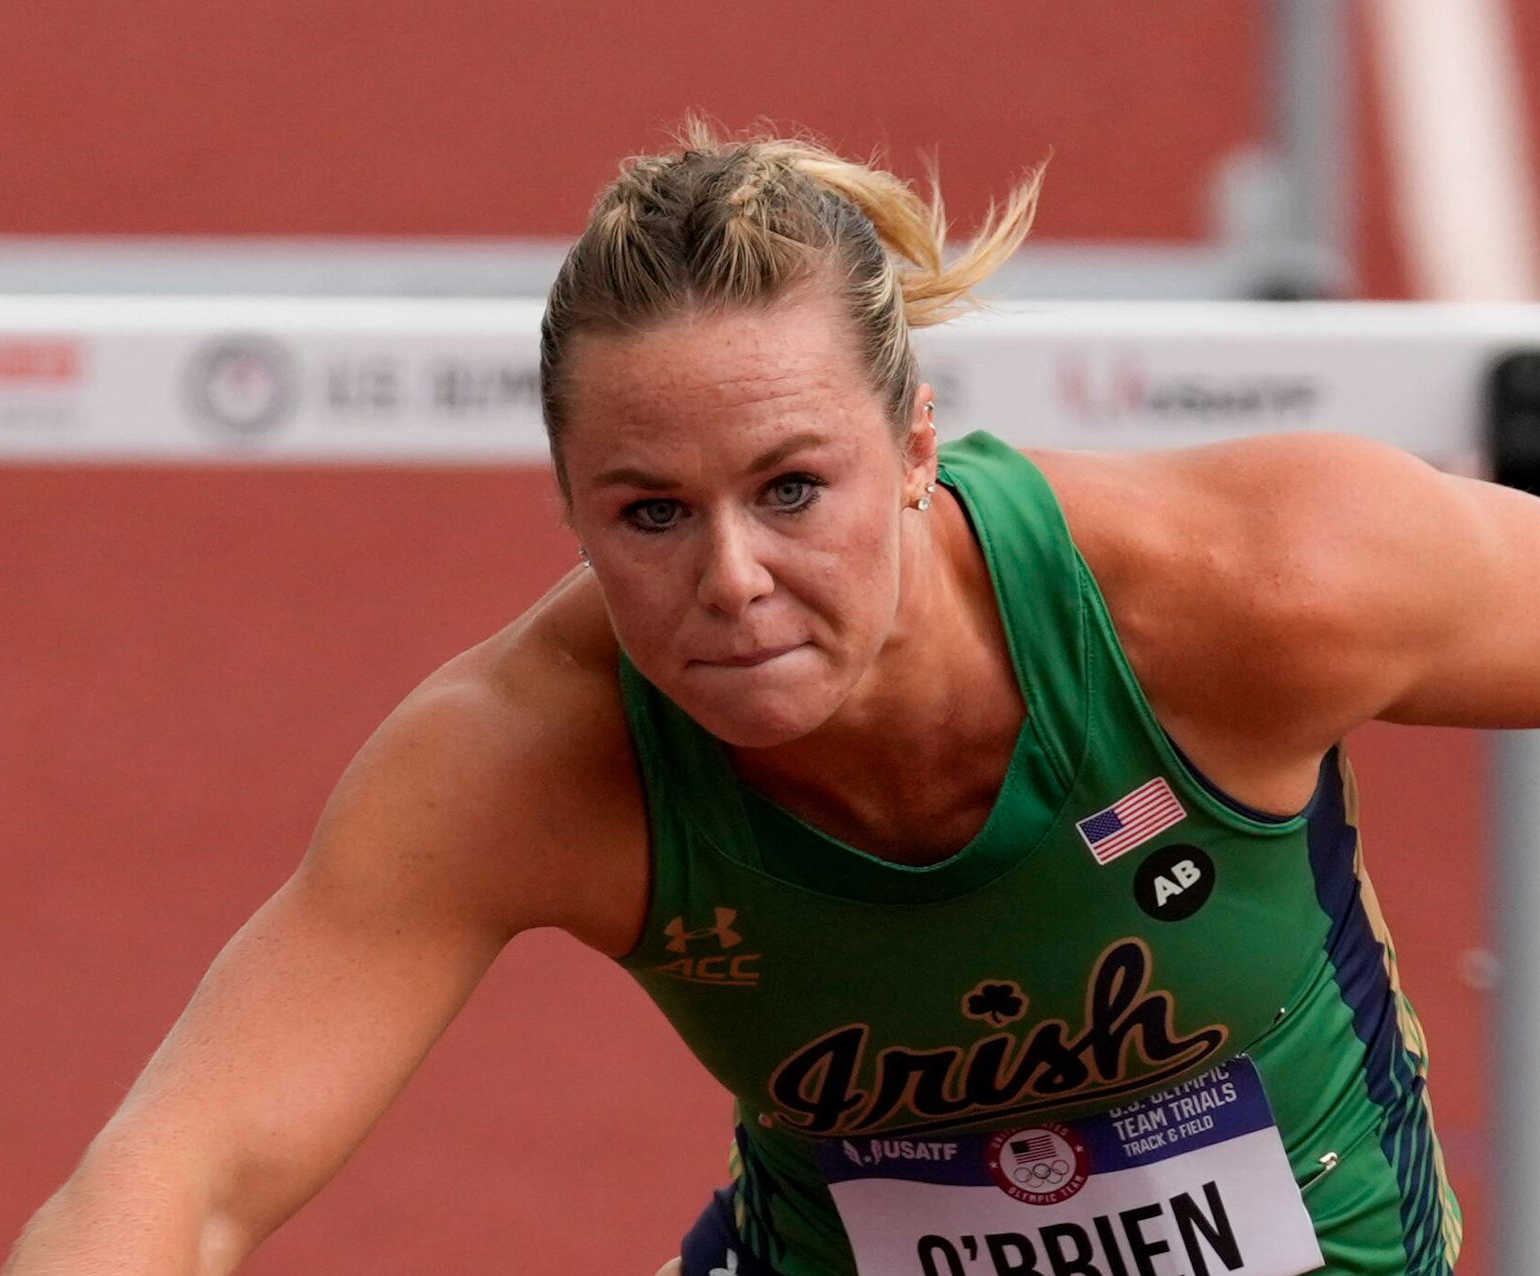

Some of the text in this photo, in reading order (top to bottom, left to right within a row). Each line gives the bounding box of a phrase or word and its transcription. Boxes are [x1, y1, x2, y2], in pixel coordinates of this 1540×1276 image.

[1154, 859, 1201, 907] AB
[655, 953, 763, 978] ACC
[768, 937, 1228, 1138] Irish
[1112, 1107, 1168, 1141] TEAM
[1168, 1082, 1238, 1121] TRIALS
[883, 1140, 958, 1161] USATF
[1123, 1115, 1214, 1157] TRACK & FIELD
